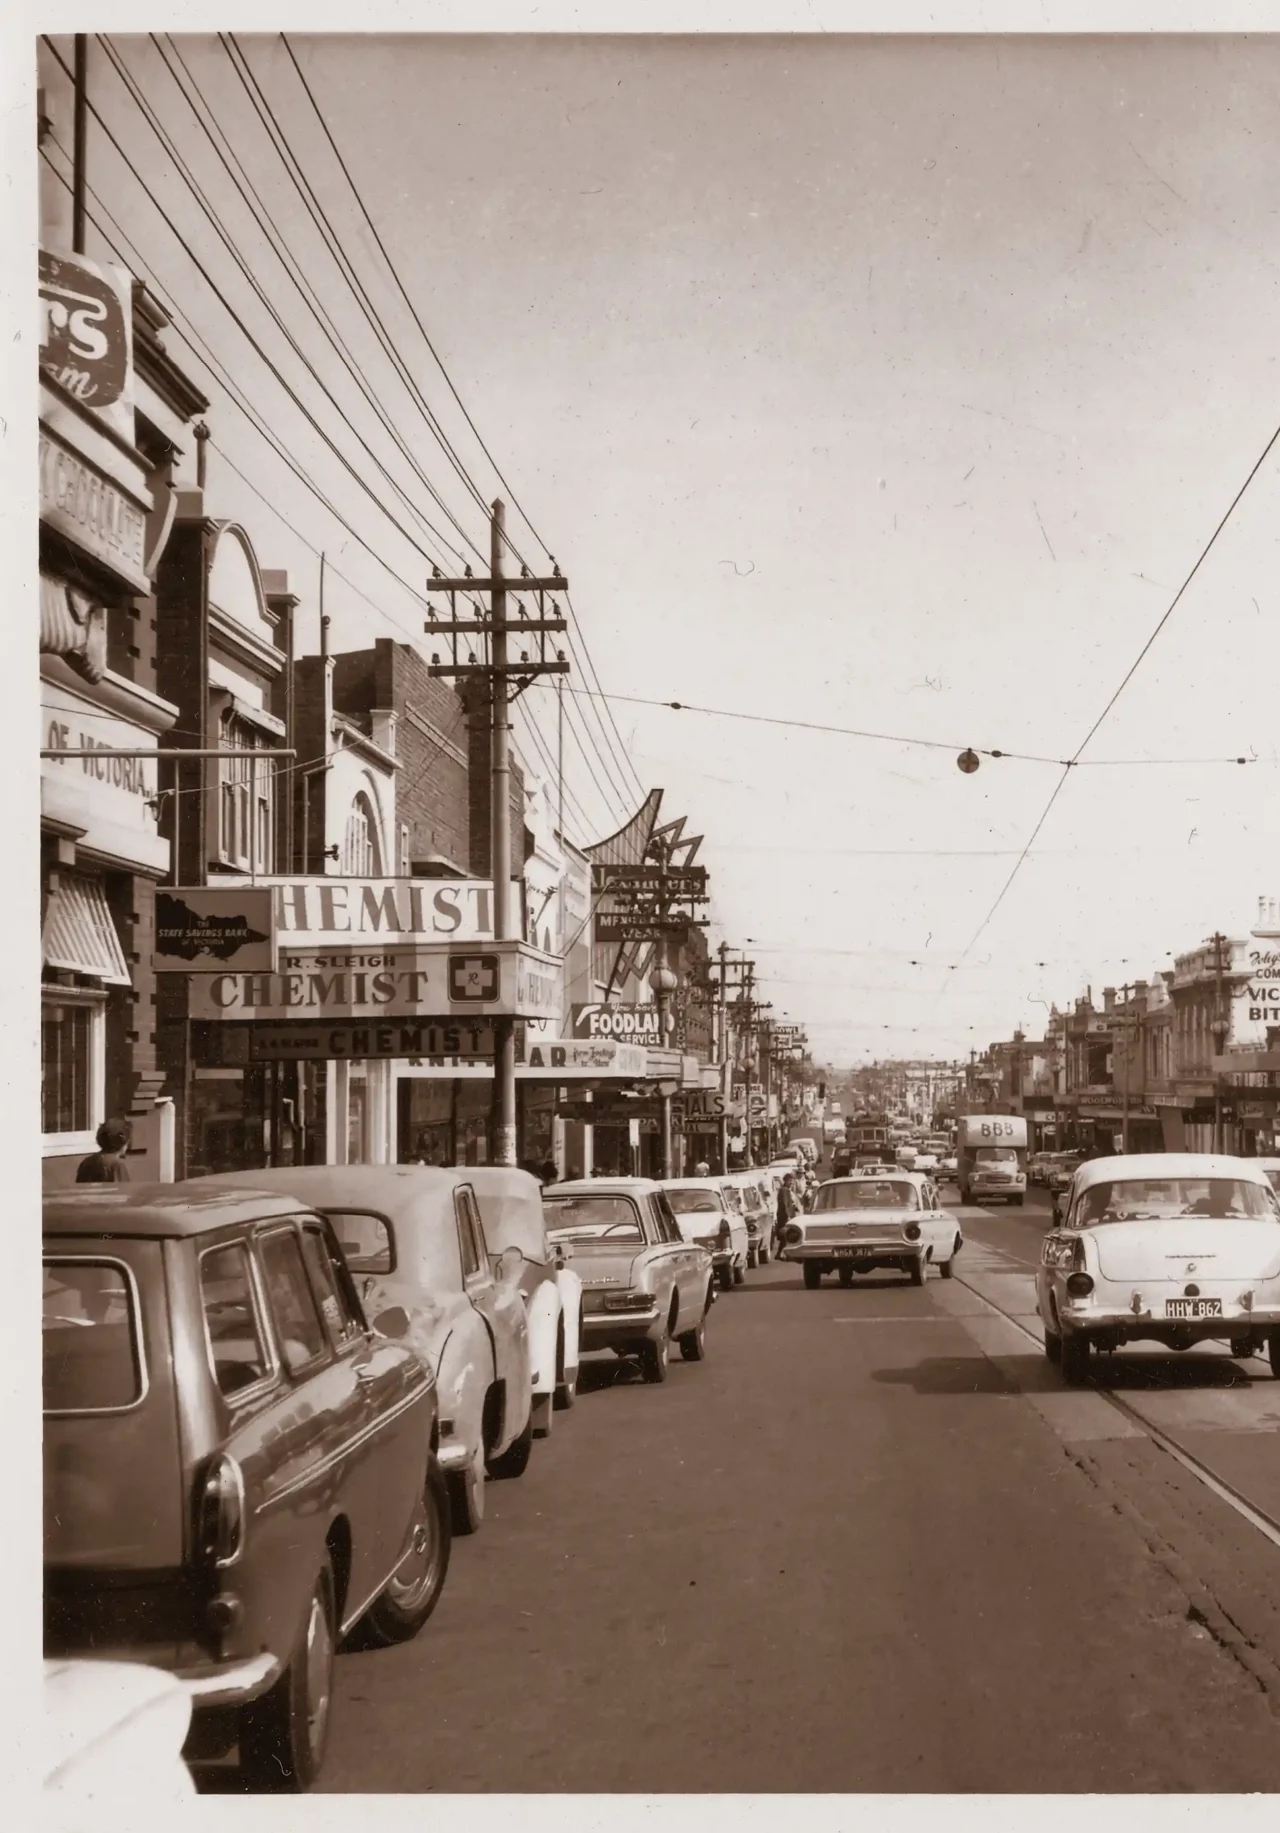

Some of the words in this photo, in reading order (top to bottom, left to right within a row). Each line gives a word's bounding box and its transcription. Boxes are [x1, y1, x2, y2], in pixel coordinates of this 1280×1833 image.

[269, 884, 494, 933] HEMIST
[158, 928, 183, 937] STATE
[186, 928, 223, 937] SAVINGS
[225, 928, 248, 937] BANK
[314, 955, 396, 968] SLEIGH
[209, 970, 429, 1007] CHEMIST
[329, 1028, 482, 1055] CHEMIST
[981, 1122, 1014, 1137] BBB
